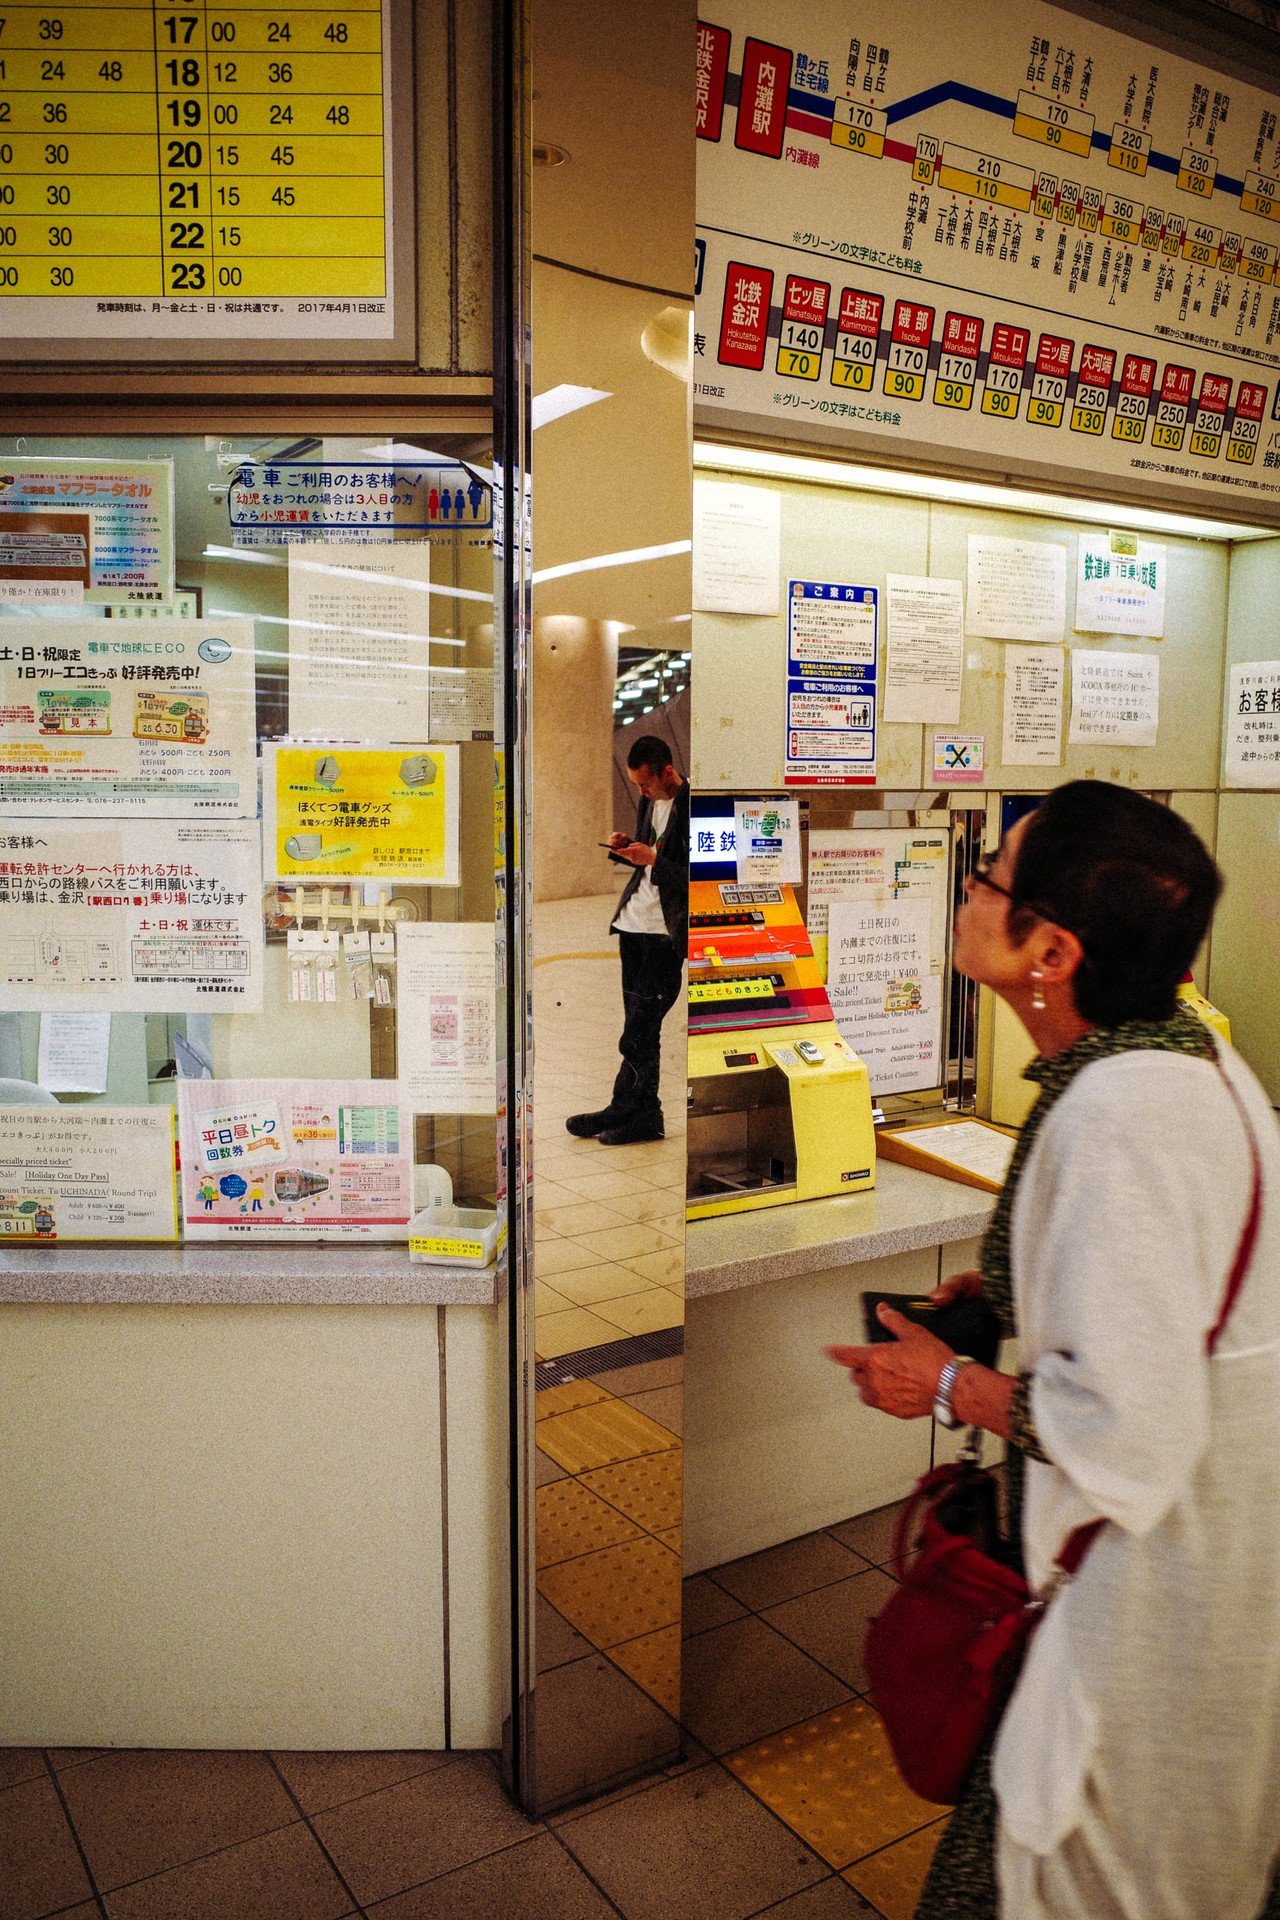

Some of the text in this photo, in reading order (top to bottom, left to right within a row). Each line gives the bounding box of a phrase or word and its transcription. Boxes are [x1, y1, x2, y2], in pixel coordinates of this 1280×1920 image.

[39, 19, 63, 40] 39
[164, 17, 198, 43] 17
[212, 23, 236, 42] 00
[267, 23, 291, 42] 24
[324, 24, 348, 43] 48
[846, 38, 860, 87] 向陽台
[863, 44, 877, 92] 四丁目
[1027, 36, 1040, 82] 五丁目
[1052, 46, 1065, 90] 六丁目
[41, 60, 65, 80] 24
[98, 61, 122, 81] 48
[166, 59, 200, 86] 18
[214, 63, 237, 82] 12
[268, 64, 292, 83] 36
[1062, 50, 1075, 95] 大根布
[1080, 57, 1094, 102] 大清台
[794, 70, 829, 93] 住宅線
[751, 61, 776, 136] 内灘駅
[1124, 74, 1138, 117] 大学前
[43, 103, 67, 123] 36
[167, 100, 201, 127] 19
[214, 105, 238, 124] 00
[848, 106, 873, 127] 170
[1047, 105, 1068, 124] 170
[1121, 132, 1142, 149] 220
[45, 144, 69, 164] 30
[167, 141, 202, 168] 20
[785, 146, 820, 168] 内灘線
[1119, 152, 1139, 170] 110
[977, 158, 1000, 177] 210
[47, 186, 71, 205] 30
[169, 182, 200, 209] 21
[975, 180, 998, 198] 110
[917, 194, 930, 224] 内灘
[1112, 201, 1133, 218] 360
[902, 191, 918, 251] 中学校前
[945, 203, 959, 247] 大根布
[960, 207, 974, 250] 大根布
[1110, 221, 1130, 237] 180
[48, 227, 72, 246] 30
[170, 223, 205, 249] 22
[975, 211, 989, 254] 四丁目
[985, 214, 999, 257] 大根布
[999, 218, 1012, 261] 五丁目
[1009, 221, 1023, 264] 大根布
[1194, 226, 1213, 243] 440
[793, 232, 924, 275] ※グリーンの文字はこども料金
[1190, 246, 1210, 262] 220
[1250, 245, 1268, 261] 490
[1068, 239, 1083, 293] 小学校前
[1247, 263, 1265, 278] 250
[50, 267, 74, 286] 30
[171, 263, 206, 290] 23
[734, 279, 762, 305] 北鉄
[788, 282, 826, 310] 七ツ屋
[298, 303, 385, 313] 2017年4月1日改正
[731, 302, 759, 328] 金沢
[786, 306, 823, 323] Nanatsuya
[842, 295, 880, 322] 上諸江
[898, 306, 929, 332] 磯部
[727, 328, 761, 343] Hokutetsu-
[787, 326, 819, 349] 140
[901, 331, 921, 343] Isobe
[948, 318, 977, 343] 割出
[726, 338, 757, 352] Kanazawa
[842, 337, 872, 360] 140
[995, 330, 1024, 354] 三口
[1040, 340, 1071, 364] 三ツ屋
[789, 354, 810, 374] 70
[894, 348, 923, 370] 170
[1082, 350, 1113, 374] 大河端
[843, 364, 864, 384] 70
[944, 359, 971, 380] 170
[991, 369, 1018, 389] 170
[1126, 361, 1151, 383] 北間
[894, 374, 914, 394] 90
[1038, 378, 1063, 398] 170
[1166, 370, 1190, 391] 蚊爪
[944, 385, 964, 403] 90
[991, 394, 1010, 412] 90
[1241, 387, 1263, 408] 内灘
[773, 393, 902, 426] ※グリーンの文字はこども料金
[1037, 403, 1055, 421] 90
[58, 483, 152, 497] マフラータオル
[236, 493, 413, 505] 幼児をおつれの場合は3人目の方
[94, 515, 158, 523] 7000系マフラータオル
[236, 510, 394, 523] から小児運賃をいただきます
[94, 546, 159, 554] 8000系マフラータオル
[1085, 552, 1157, 590] 鉄道線 1日乗り放題
[127, 592, 163, 600] 北陸鉄道
[814, 586, 854, 600] ご案内
[0, 646, 81, 662] 土・日・祝限定
[88, 642, 185, 653] 電車で地球にECO
[17, 666, 118, 680] 1日フリーエコきっぷ
[1080, 680, 1102, 690] ICOCA
[1131, 684, 1138, 692] IC
[1079, 723, 1120, 733] 利用できます。
[298, 802, 392, 813] ほくてつ電車グッズ
[0, 863, 199, 877] 運転免許センターへ行かれる方は、
[0, 877, 226, 891] 西口からの路線バスをご利用願います。
[139, 919, 239, 932] 土・日・祝 運休です。
[859, 917, 900, 931] 土日祝日の
[841, 932, 916, 949] 内灘までの往復には
[840, 950, 922, 966] エコ切符がお得です。
[834, 985, 859, 997] Sale!!
[875, 1070, 920, 1082] Ticket Counter.
[202, 1119, 276, 1145] 平日昼トク
[207, 1145, 244, 1161] 回数券
[74, 1172, 89, 1181] Day
[21, 1186, 46, 1195] Ticket.
[48, 1187, 59, 1195] To
[112, 1189, 136, 1197] Round
[137, 1189, 157, 1198] Trip)
